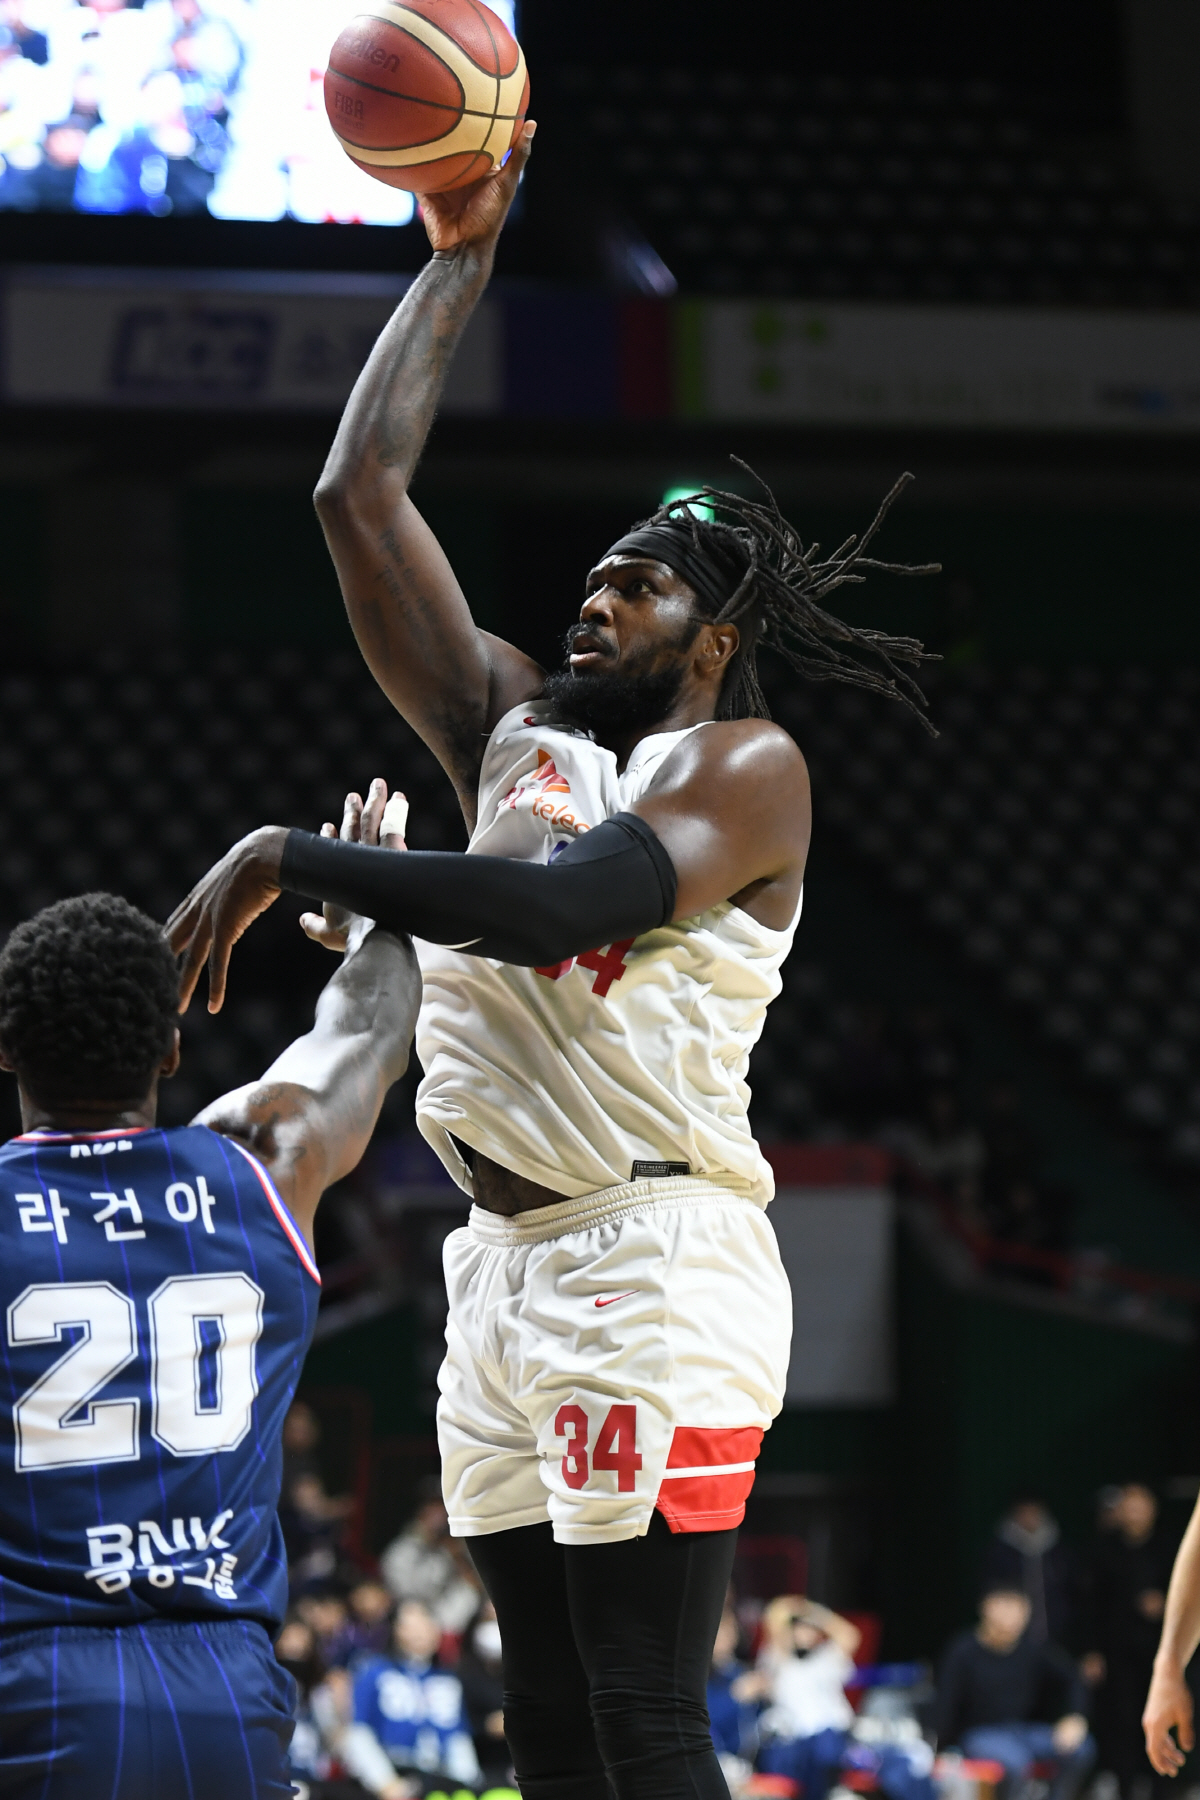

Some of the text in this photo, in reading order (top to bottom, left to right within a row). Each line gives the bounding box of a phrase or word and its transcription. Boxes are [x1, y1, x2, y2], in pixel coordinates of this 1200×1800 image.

[340, 36, 400, 74] olten
[334, 91, 364, 119] FIBA
[534, 936, 637, 998] 4
[6, 1271, 265, 1473] 20
[554, 1404, 643, 1493] 34
[86, 1508, 234, 1568] BNK
